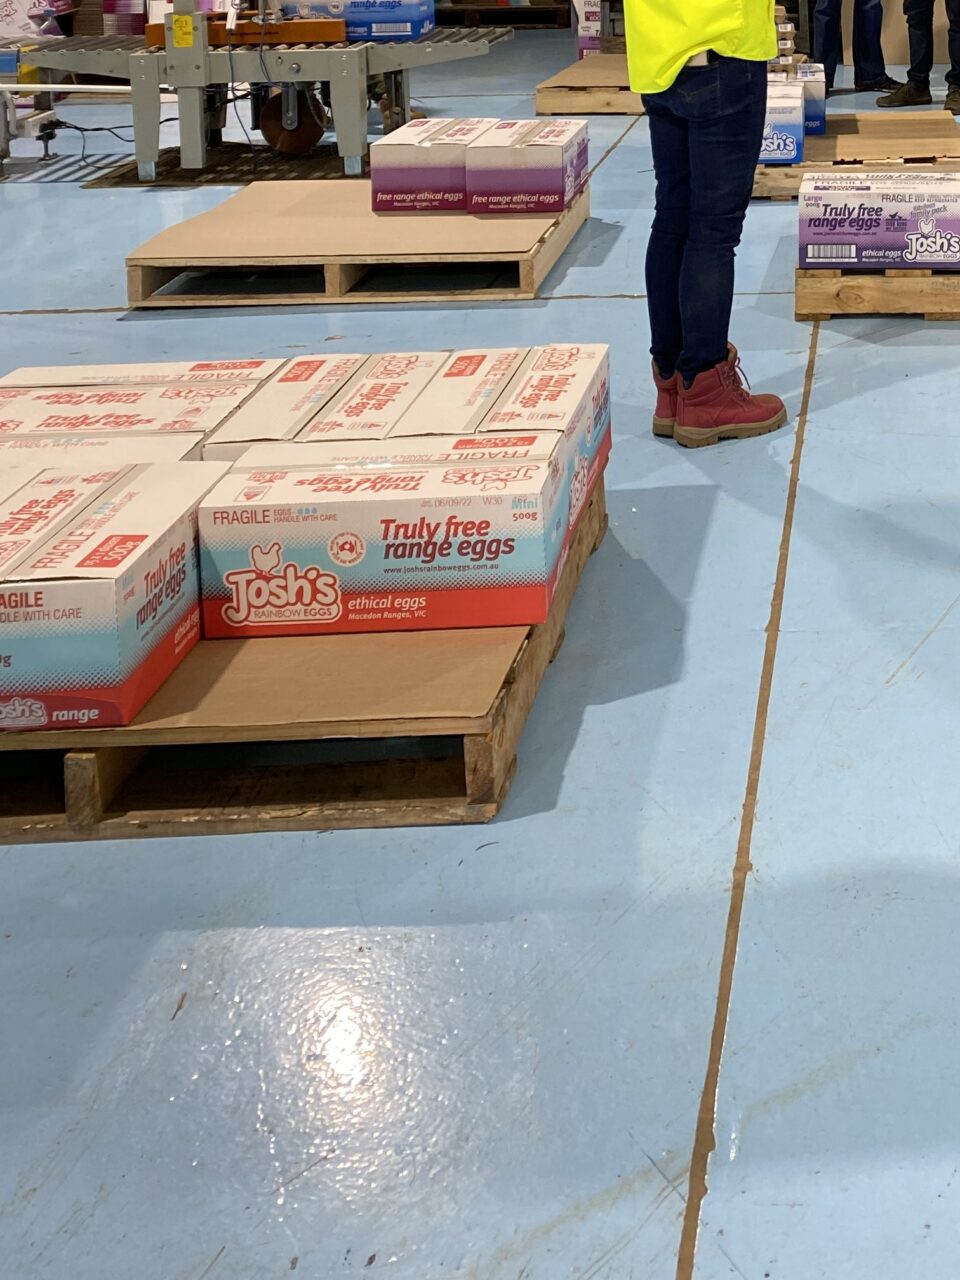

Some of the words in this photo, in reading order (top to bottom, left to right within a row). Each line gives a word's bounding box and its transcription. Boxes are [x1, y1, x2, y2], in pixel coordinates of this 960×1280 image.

[377, 192, 393, 202] free
[393, 193, 416, 202] range
[417, 191, 443, 201] ethical
[444, 192, 463, 202] eggs
[472, 194, 488, 204] free
[488, 195, 511, 204] range
[512, 193, 539, 203] ethical
[540, 194, 559, 204] eggs
[881, 193, 913, 203] FRAGILE
[822, 203, 856, 220] Truly
[857, 203, 883, 220] free
[808, 217, 846, 232] range
[848, 217, 882, 232] eggs
[904, 230, 960, 261] Josh's
[862, 249, 885, 257] ethical
[885, 250, 902, 259] eggs
[435, 449, 531, 462] FRAGILE
[293, 476, 354, 487] eggs
[356, 474, 426, 487] range
[440, 464, 540, 486] Josh's
[311, 482, 364, 495] free
[361, 478, 422, 494] Truly
[434, 497, 472, 508] 06/09/22
[8, 510, 52, 536] range
[40, 489, 76, 511] eggs
[213, 509, 271, 526] FRAGILE
[273, 508, 292, 516] EGGS
[273, 515, 301, 524] HANDLE
[301, 513, 319, 522] WITH
[319, 513, 338, 522] CARE
[512, 511, 538, 522] 500g
[380, 515, 441, 544] Truly
[442, 514, 491, 543] free
[30, 530, 96, 569] FRAGILE
[102, 541, 142, 561] 500g
[383, 538, 453, 565] range
[456, 537, 516, 562] eggs
[143, 557, 169, 598] Truly
[168, 541, 187, 577] free
[0, 591, 44, 609] AGILE
[135, 584, 165, 631] range
[163, 561, 187, 601] eggs
[224, 563, 339, 624] Josh's
[348, 594, 391, 610] ethical
[394, 596, 427, 611] eggs
[22, 609, 50, 622] WITH
[52, 607, 82, 619] CARE
[253, 607, 302, 619] RAINBOW
[303, 606, 333, 618] EGGS
[347, 611, 382, 621] Macedon
[383, 610, 412, 619] Ranges,
[414, 609, 427, 618] VIC
[52, 708, 99, 724] range
